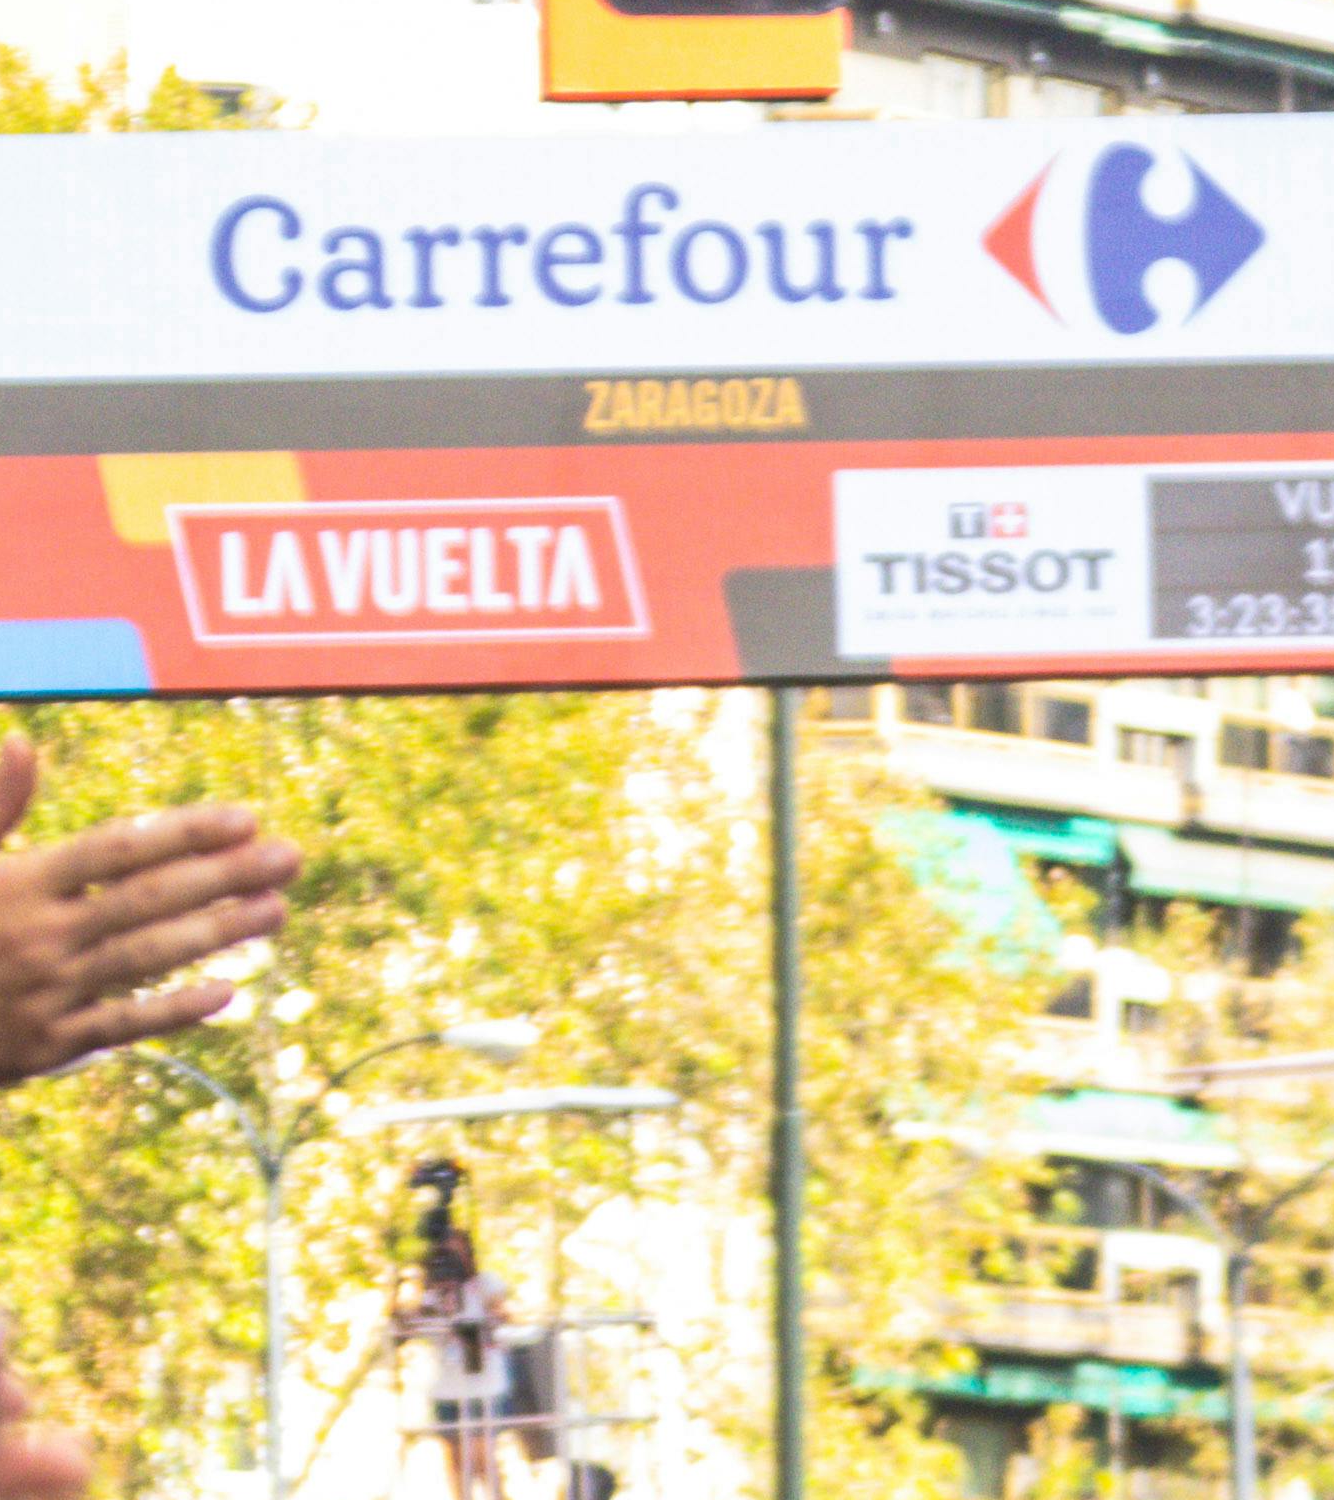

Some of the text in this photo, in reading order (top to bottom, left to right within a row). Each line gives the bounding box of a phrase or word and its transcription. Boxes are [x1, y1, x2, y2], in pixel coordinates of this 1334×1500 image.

[208, 181, 914, 314] Carrefour
[581, 375, 809, 434] ZARAGOZA
[219, 524, 601, 616] LA VUELTA
[863, 548, 1115, 596] TISSOT
